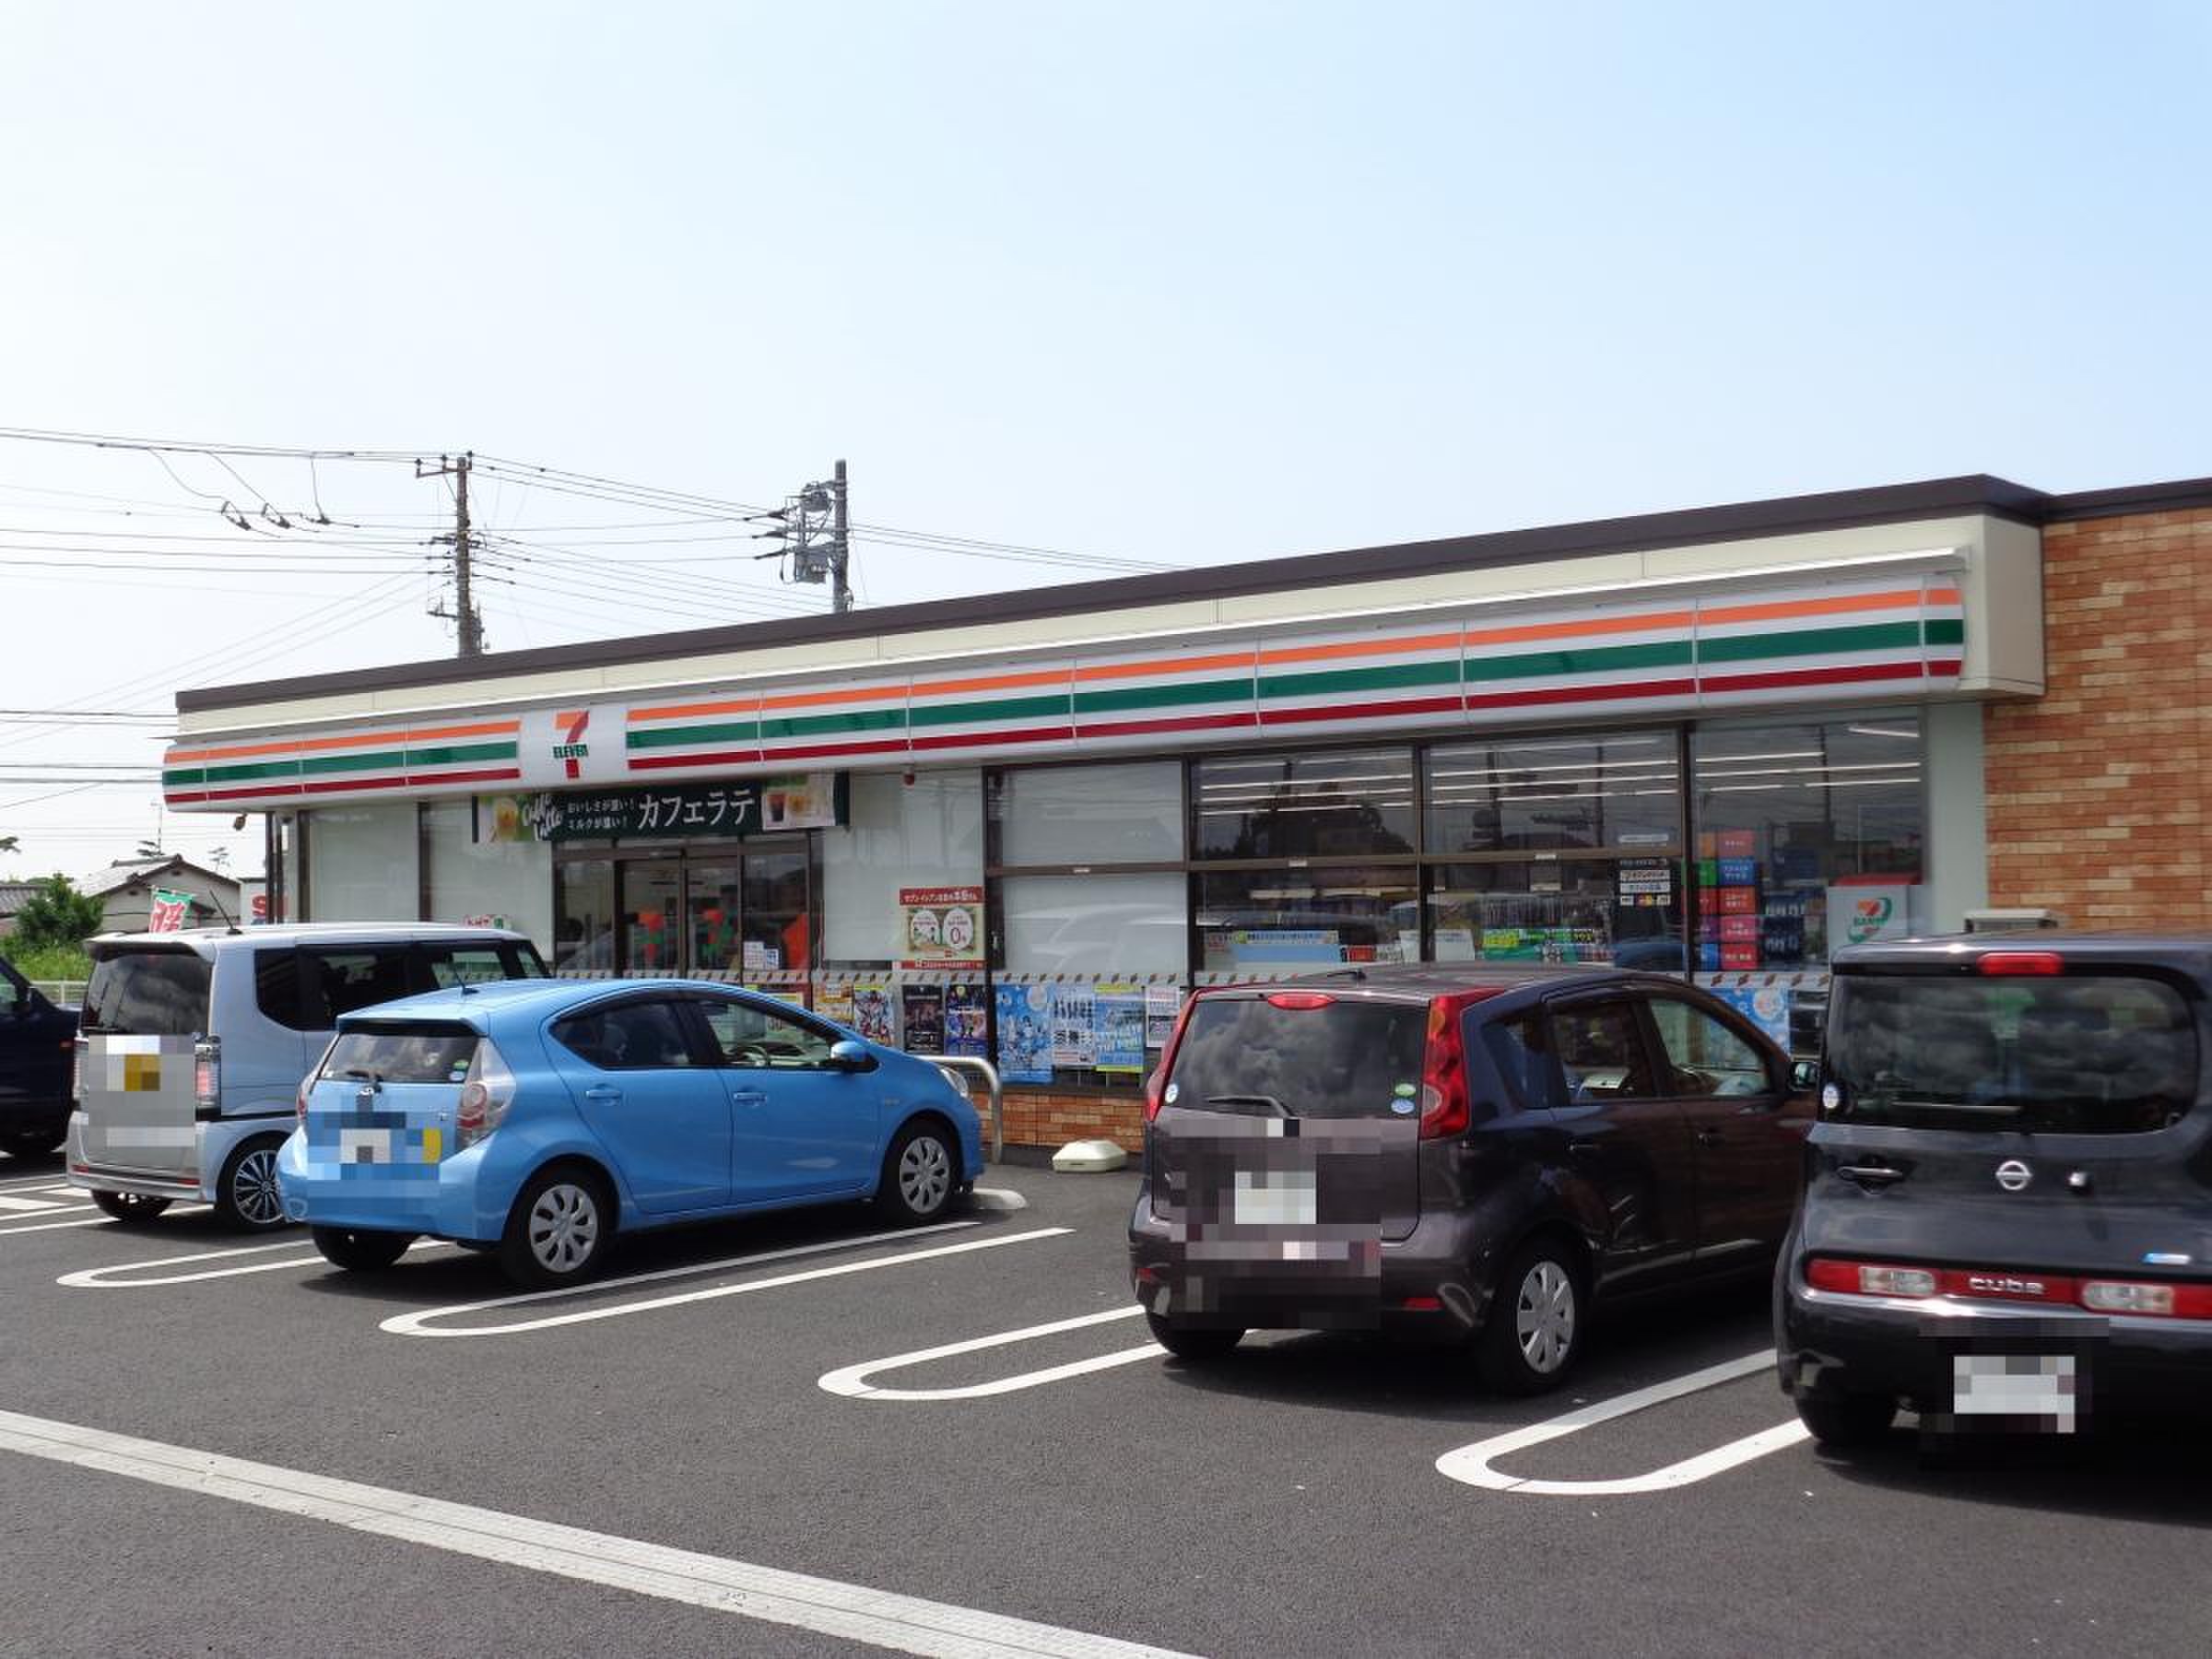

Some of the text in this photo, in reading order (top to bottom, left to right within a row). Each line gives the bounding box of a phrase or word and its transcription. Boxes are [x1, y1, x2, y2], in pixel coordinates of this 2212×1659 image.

[638, 789, 755, 829] カフェラテ
